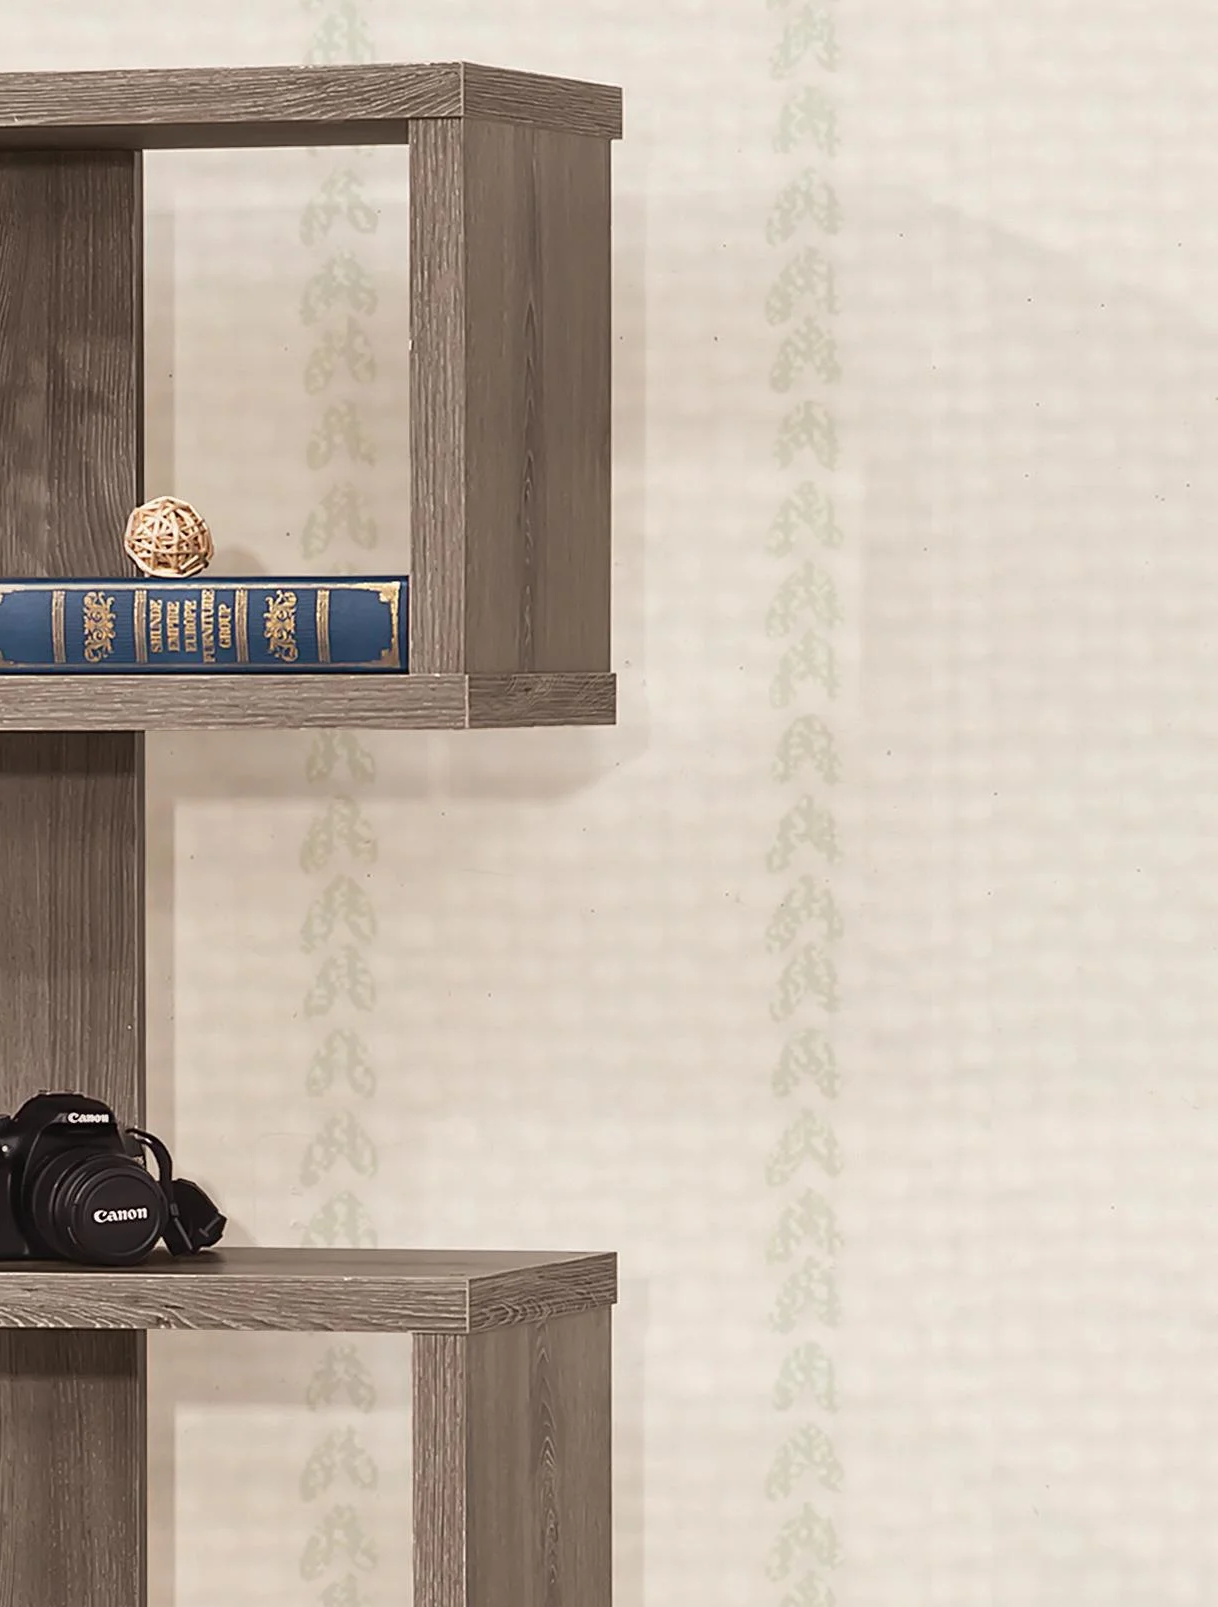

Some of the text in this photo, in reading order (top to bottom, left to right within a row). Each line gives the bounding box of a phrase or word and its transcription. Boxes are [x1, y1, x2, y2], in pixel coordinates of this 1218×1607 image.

[184, 599, 197, 653] EUROPE
[218, 603, 231, 649] GROUP
[67, 1112, 109, 1123] Canon
[93, 1207, 148, 1223] Canon
